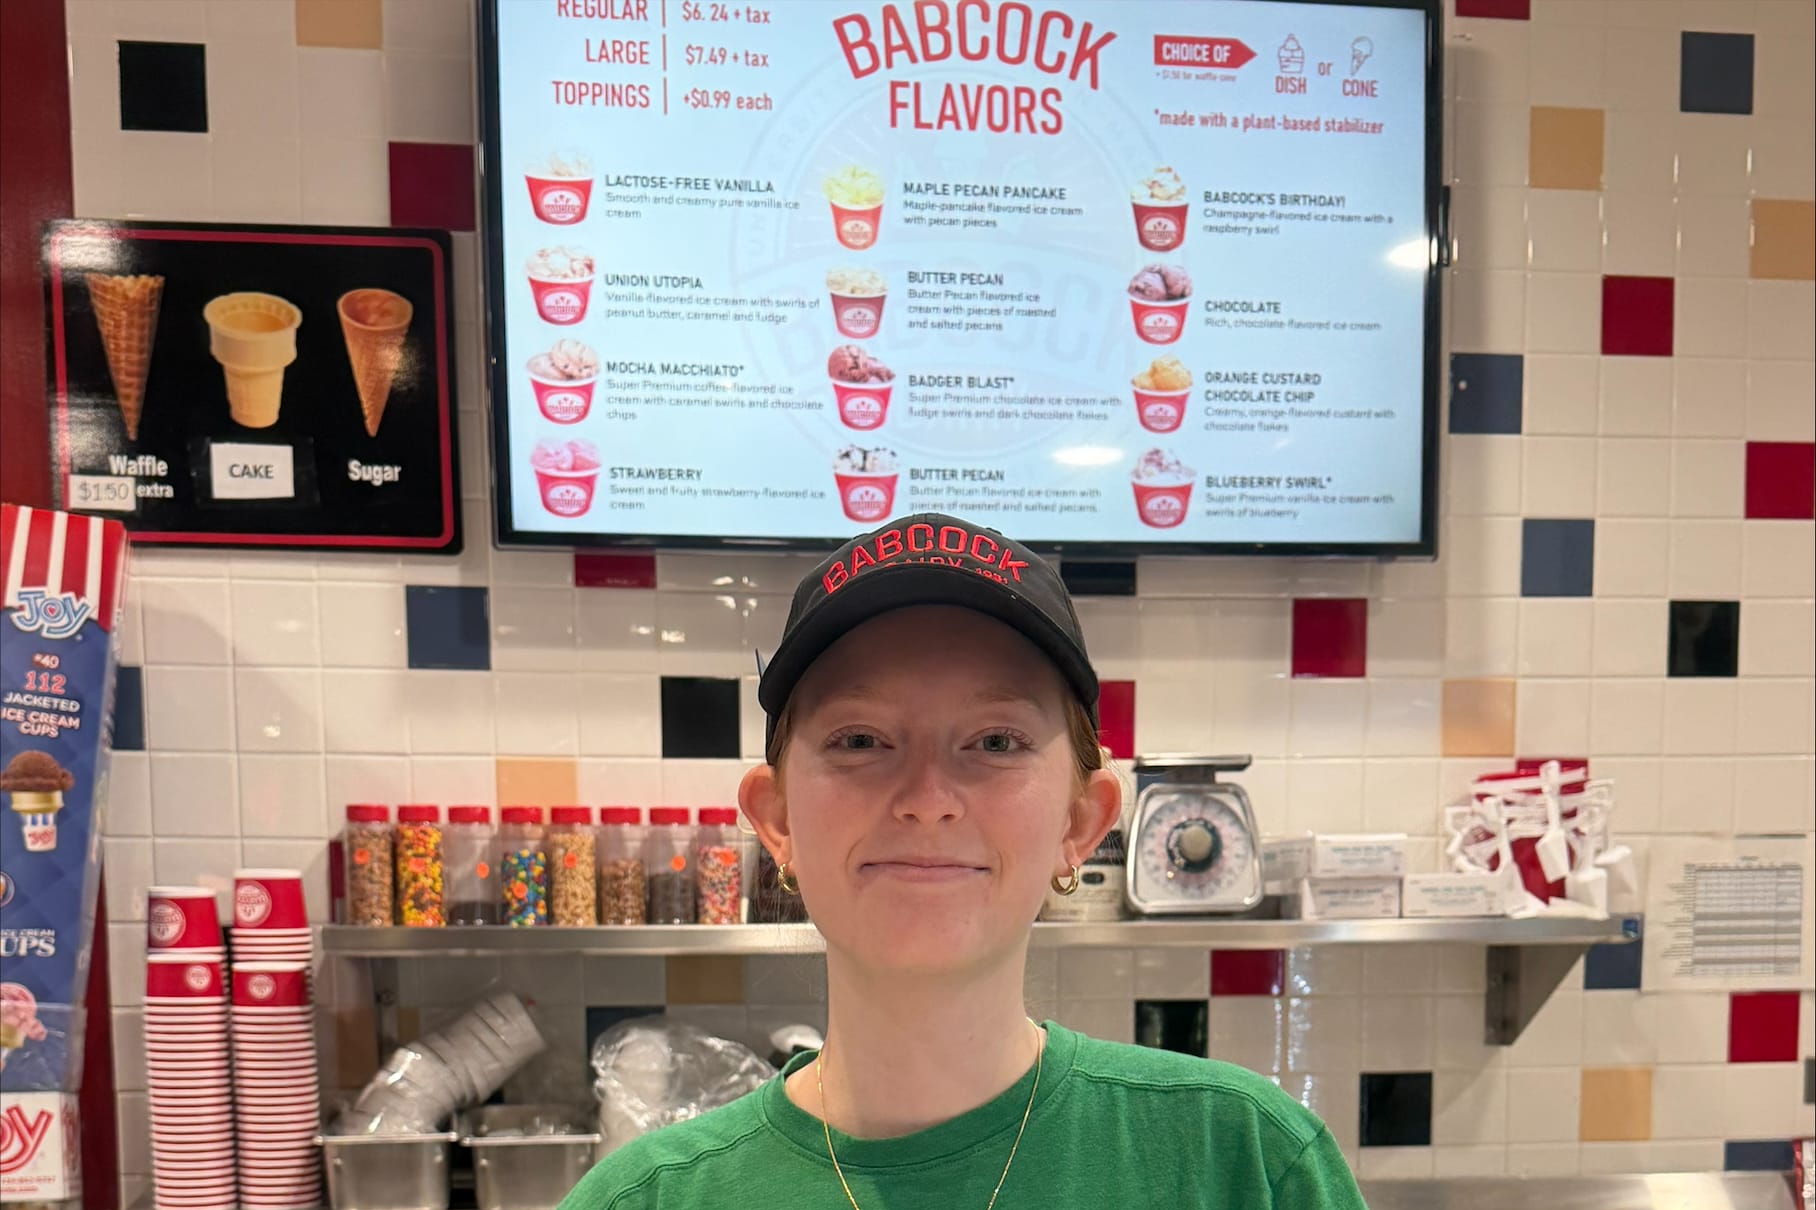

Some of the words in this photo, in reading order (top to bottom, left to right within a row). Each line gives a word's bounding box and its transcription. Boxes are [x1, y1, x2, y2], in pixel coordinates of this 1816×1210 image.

[557, 0, 648, 21] REGULAR
[746, 7, 771, 24] tax
[585, 38, 650, 65] LARGE
[685, 44, 727, 67] $7.49
[744, 49, 769, 67] tax
[832, 0, 1117, 91] BABCOCK
[1162, 42, 1210, 62] CHOICE
[1213, 44, 1231, 63] OF
[1317, 61, 1333, 76] or
[1275, 75, 1307, 94] DISH
[1342, 79, 1379, 98] CONE
[552, 80, 650, 108] TOPPINGS
[736, 92, 773, 111] each
[889, 80, 1063, 135] FLAVORS
[1199, 112, 1227, 128] with
[1230, 116, 1239, 128] a
[1243, 113, 1320, 133] plant-based
[1324, 117, 1383, 135] stabilizer
[605, 174, 710, 191] LACTOSE-FREE
[714, 178, 775, 193] VANILLA
[904, 182, 950, 196] MAPLE
[953, 184, 999, 198] PECAN
[1003, 186, 1066, 200] PANCAKE
[1204, 191, 1276, 206] BABCOCK'S
[605, 274, 649, 288] UNION
[654, 275, 703, 289] UTOPIA
[908, 271, 957, 284] BUTTER
[960, 273, 1003, 286] PECAN
[1205, 300, 1281, 314] CHOCOLATE
[606, 361, 656, 375] MOCHA
[909, 375, 962, 388] BADGER
[1205, 372, 1258, 385] ORANGE
[1262, 372, 1322, 386] CUSTARD
[1205, 389, 1281, 403] CHOCOLATE
[1285, 390, 1315, 404] CHIP
[108, 453, 168, 477] Waffle
[229, 463, 274, 480] CAKE
[347, 458, 402, 487] Sugar
[610, 467, 702, 481] STRAWBERRY
[910, 468, 958, 481] BUTTER
[961, 469, 1005, 482] PECAN
[1206, 476, 1281, 489] BLUEBERRY
[136, 483, 174, 499] extra
[821, 523, 1029, 595] BABCOCK
[25, 671, 66, 695] 112
[4, 692, 80, 713] JACKETED
[2, 707, 25, 722] ICE
[28, 709, 80, 730] CREAM
[20, 720, 59, 738] CUPS
